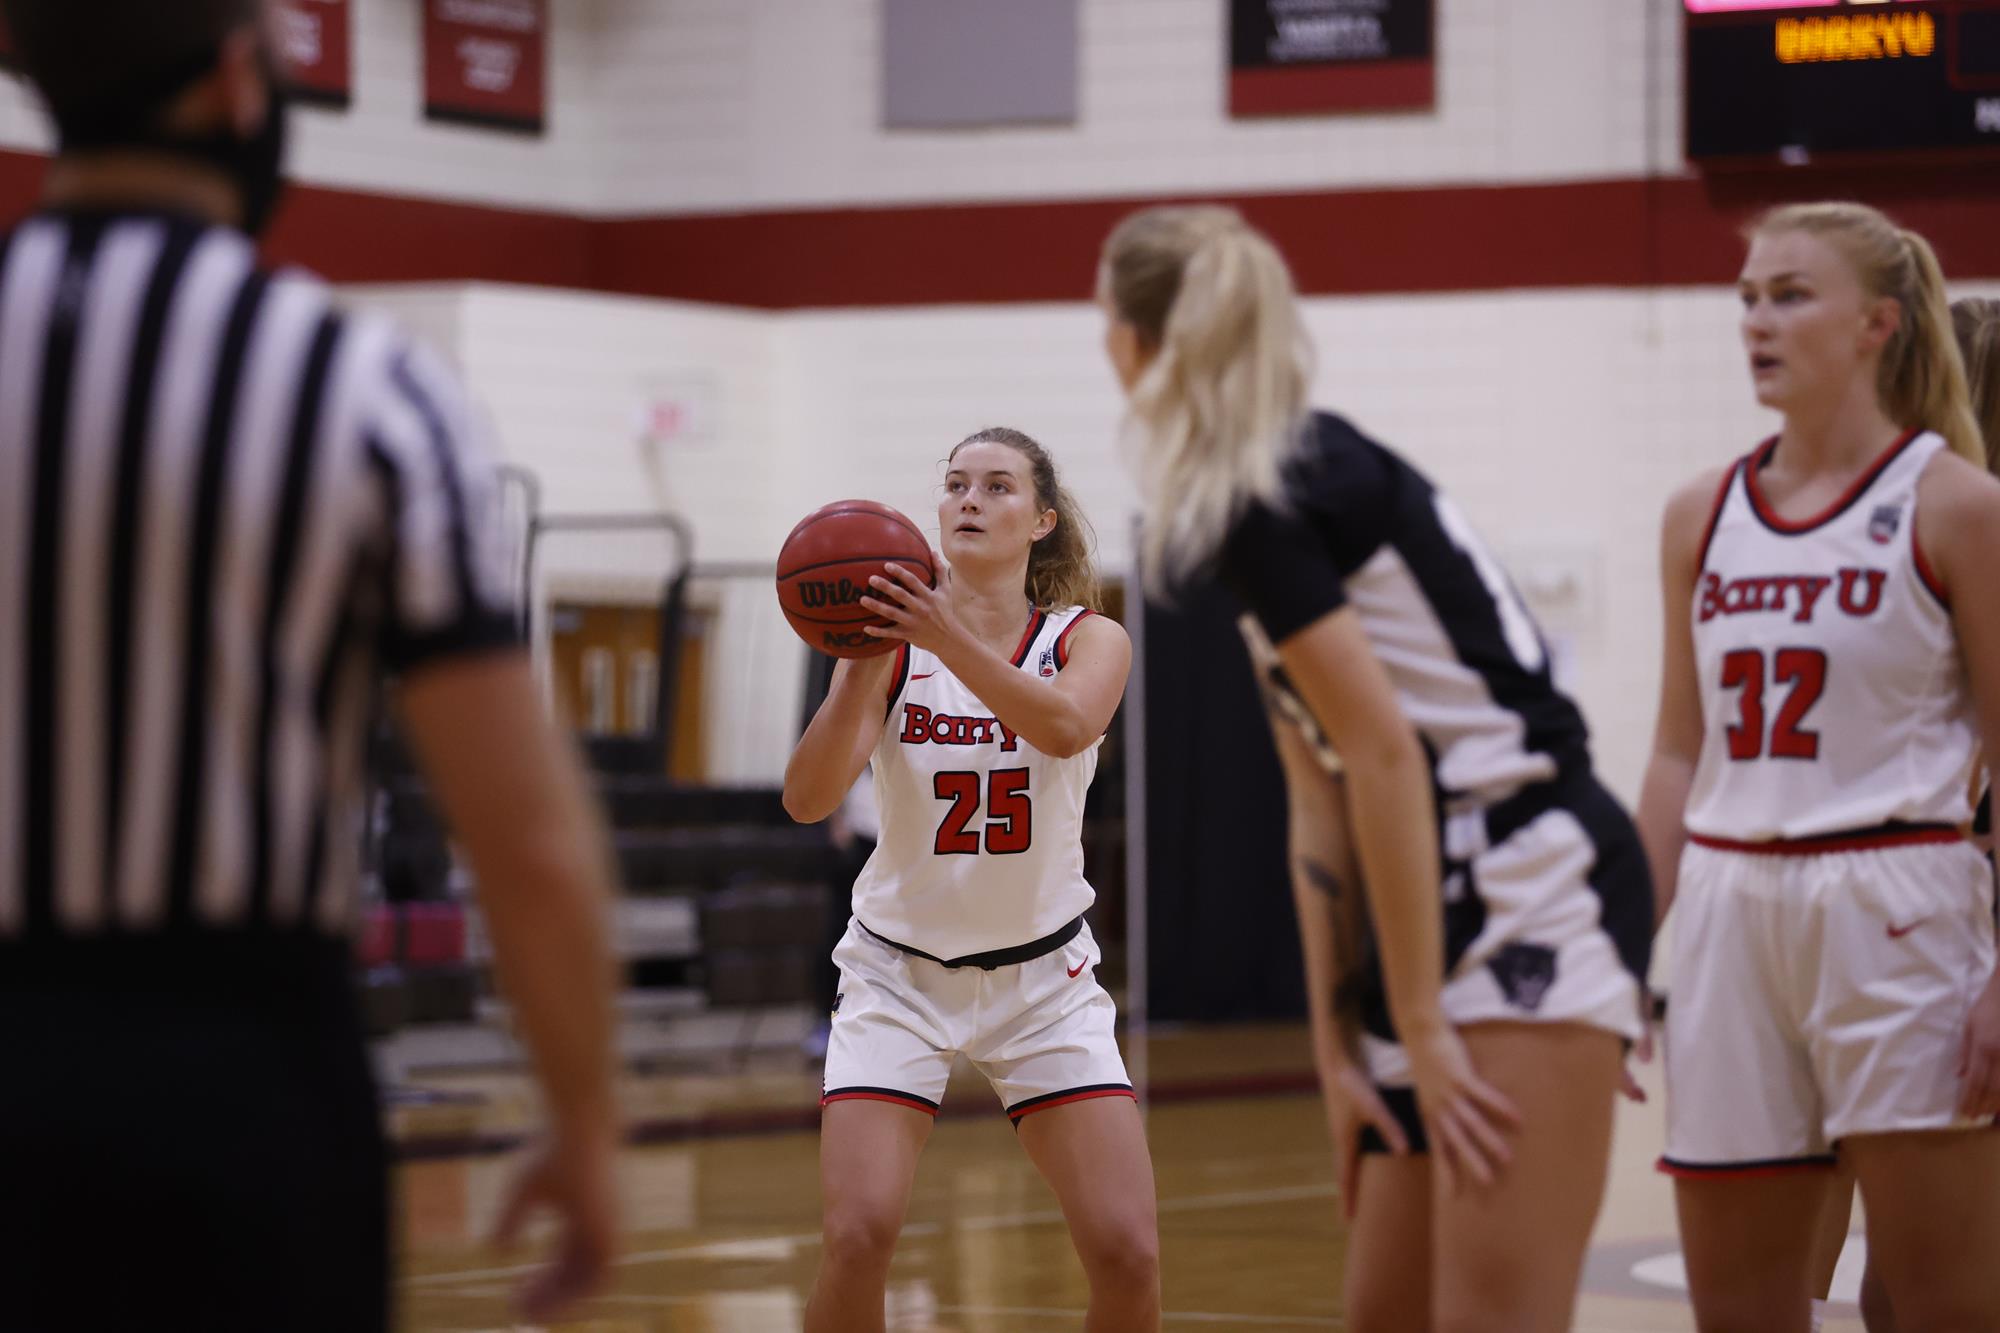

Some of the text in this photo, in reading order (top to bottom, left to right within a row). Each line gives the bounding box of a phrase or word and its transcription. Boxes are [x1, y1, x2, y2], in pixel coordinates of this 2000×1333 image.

[799, 577, 880, 608] Wils
[1699, 567, 1887, 623] Barry U
[900, 703, 1018, 752] Barry
[1721, 647, 1827, 761] 32
[933, 767, 1032, 855] 25
